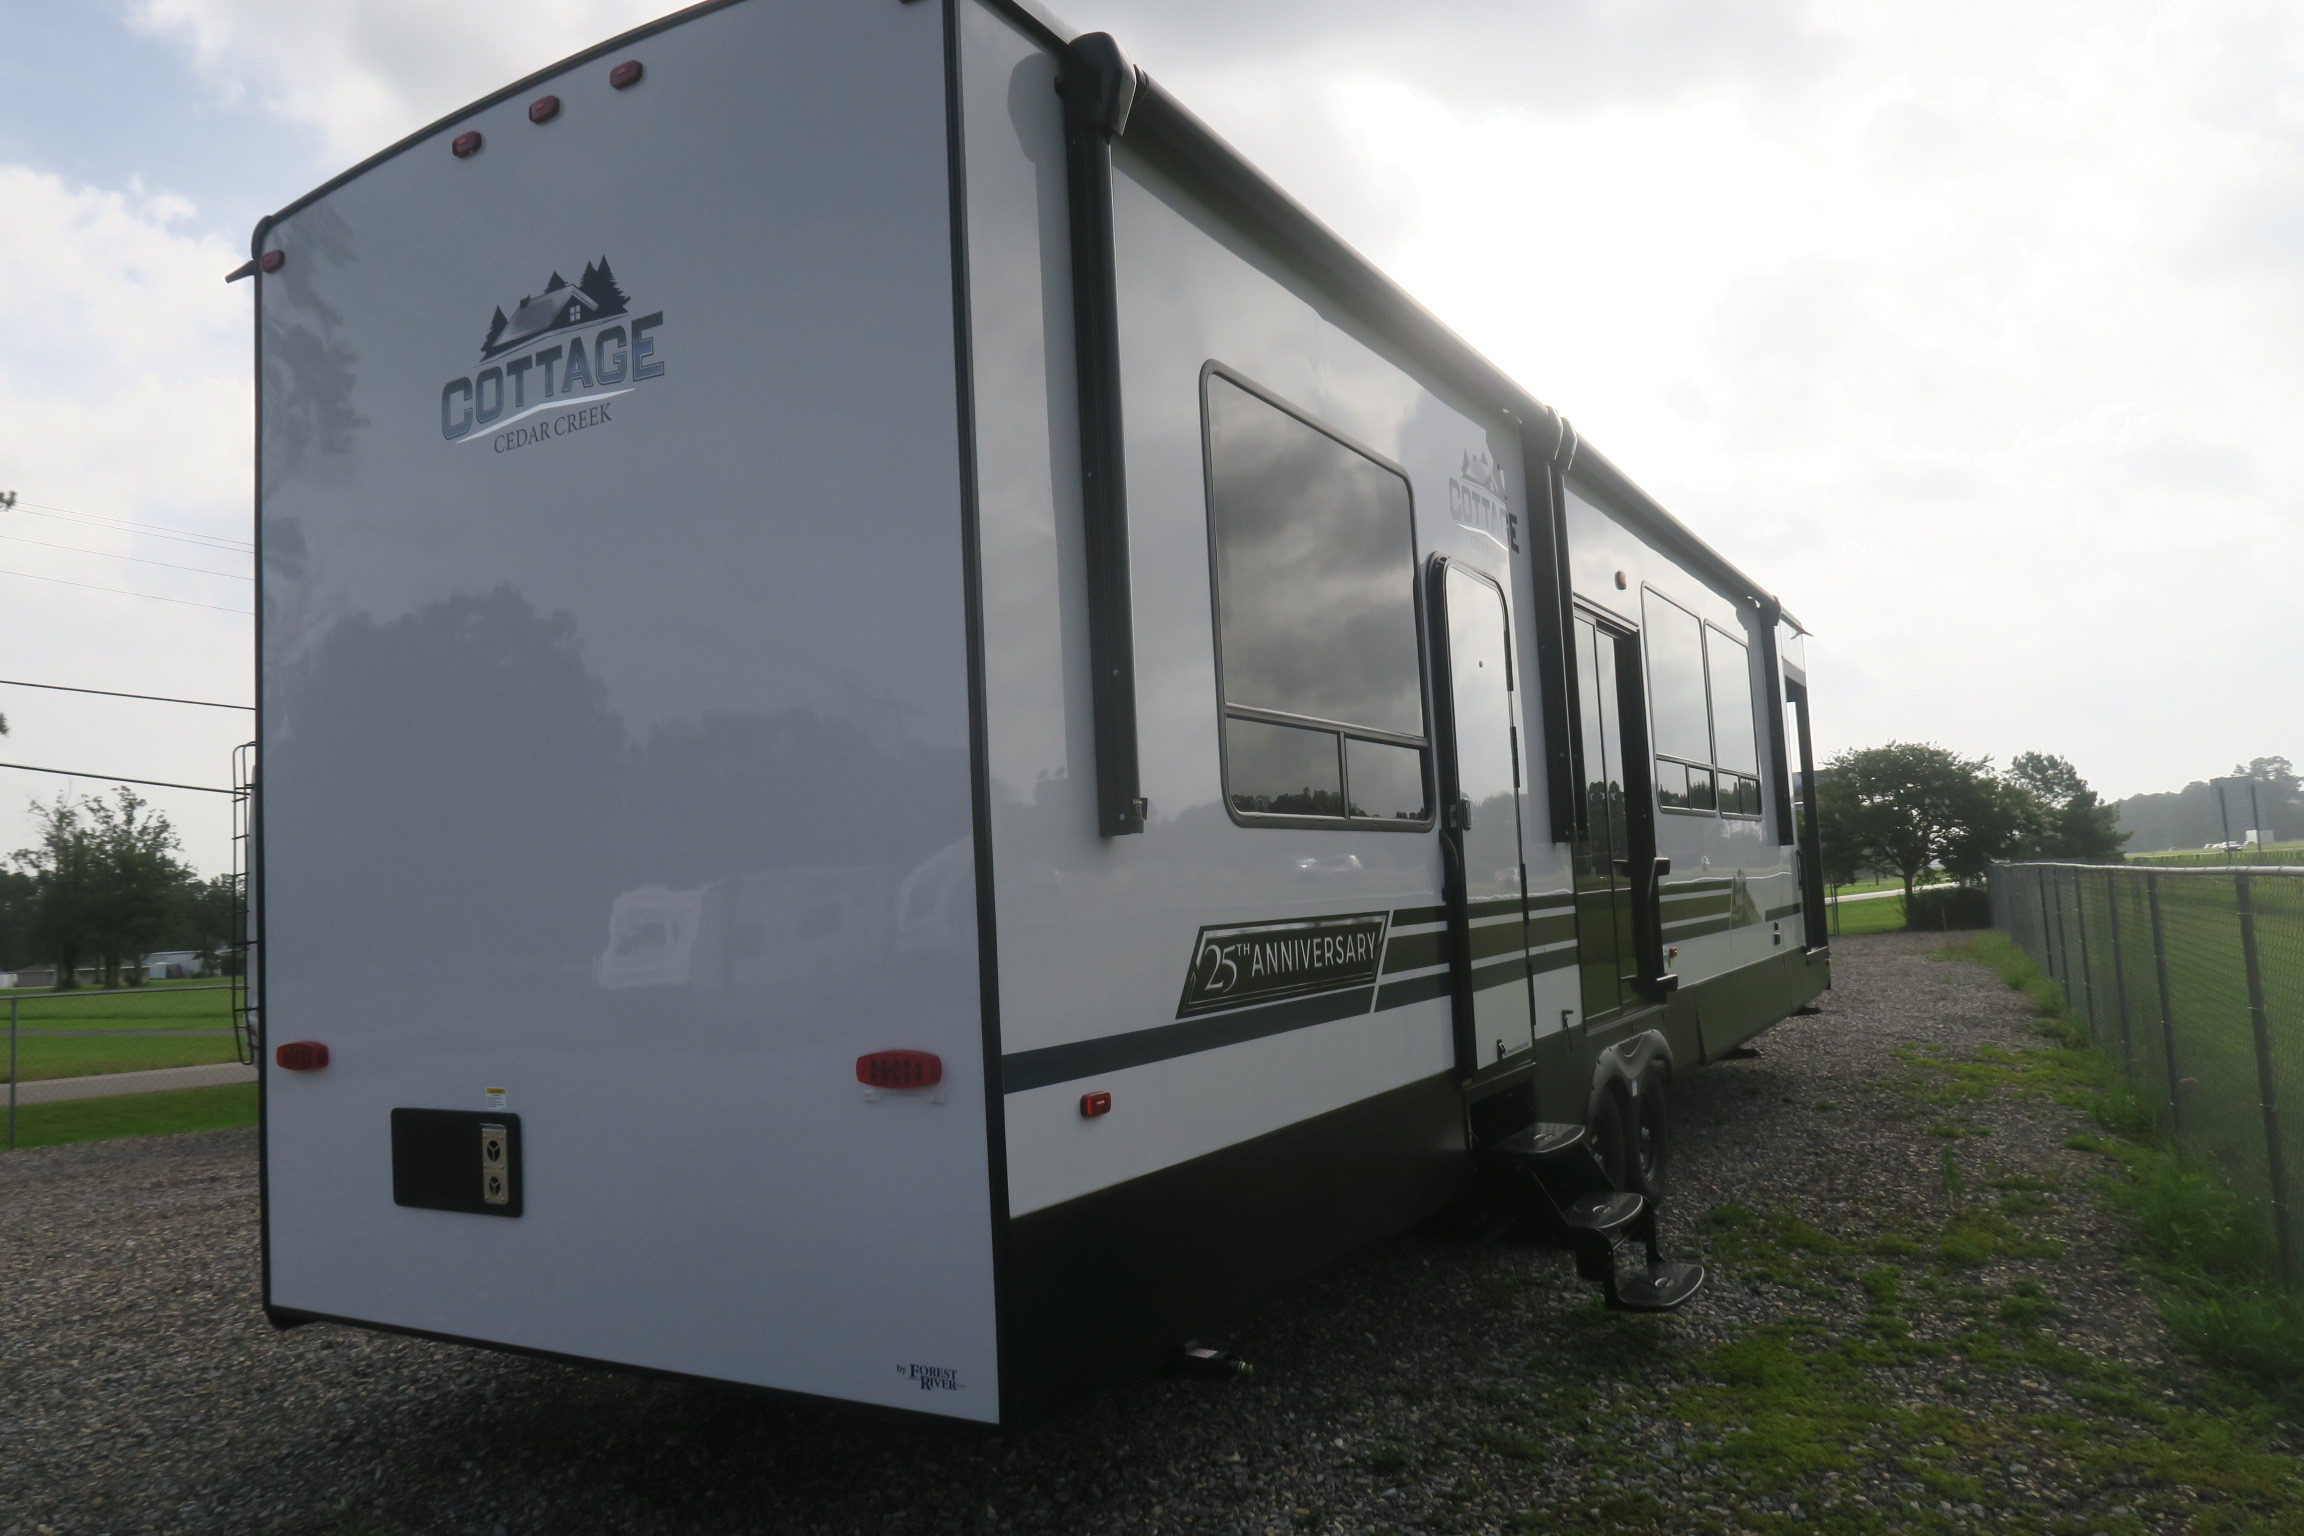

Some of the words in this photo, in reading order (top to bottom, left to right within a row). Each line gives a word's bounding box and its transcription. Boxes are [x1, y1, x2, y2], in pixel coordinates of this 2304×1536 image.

[442, 311, 665, 440] COTTAGE
[494, 422, 550, 454] CEDAR
[554, 402, 612, 436] CREEK
[1252, 931, 1376, 978] ANNIVERSARY
[896, 1364, 906, 1375] by
[909, 1363, 958, 1380] FOREST
[920, 1376, 957, 1391] RIVER
